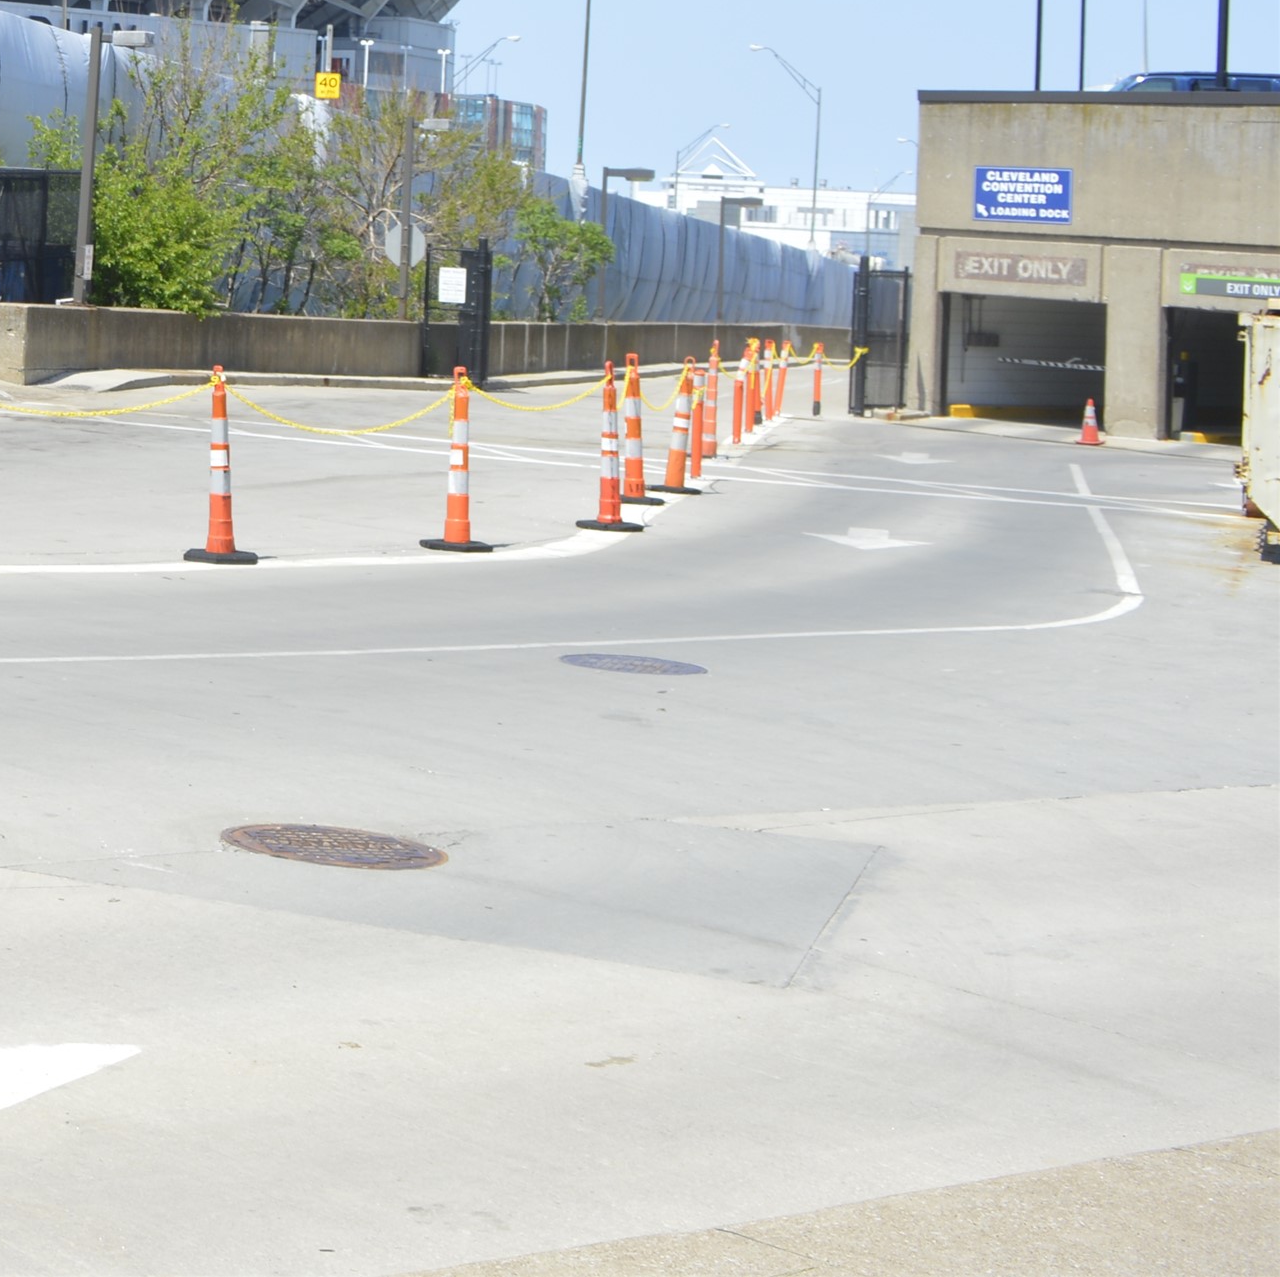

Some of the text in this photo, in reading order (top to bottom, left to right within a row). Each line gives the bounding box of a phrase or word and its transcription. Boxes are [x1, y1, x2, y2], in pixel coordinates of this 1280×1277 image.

[319, 77, 338, 88] 40
[985, 170, 1060, 183] CLEVELAND
[981, 181, 1064, 195] CONVENTION
[996, 192, 1048, 205] CENTER
[990, 206, 1070, 219] LOADING DOCK
[965, 256, 1073, 280] EXIT ONLY
[1226, 282, 1280, 297] EXIT ONLY
